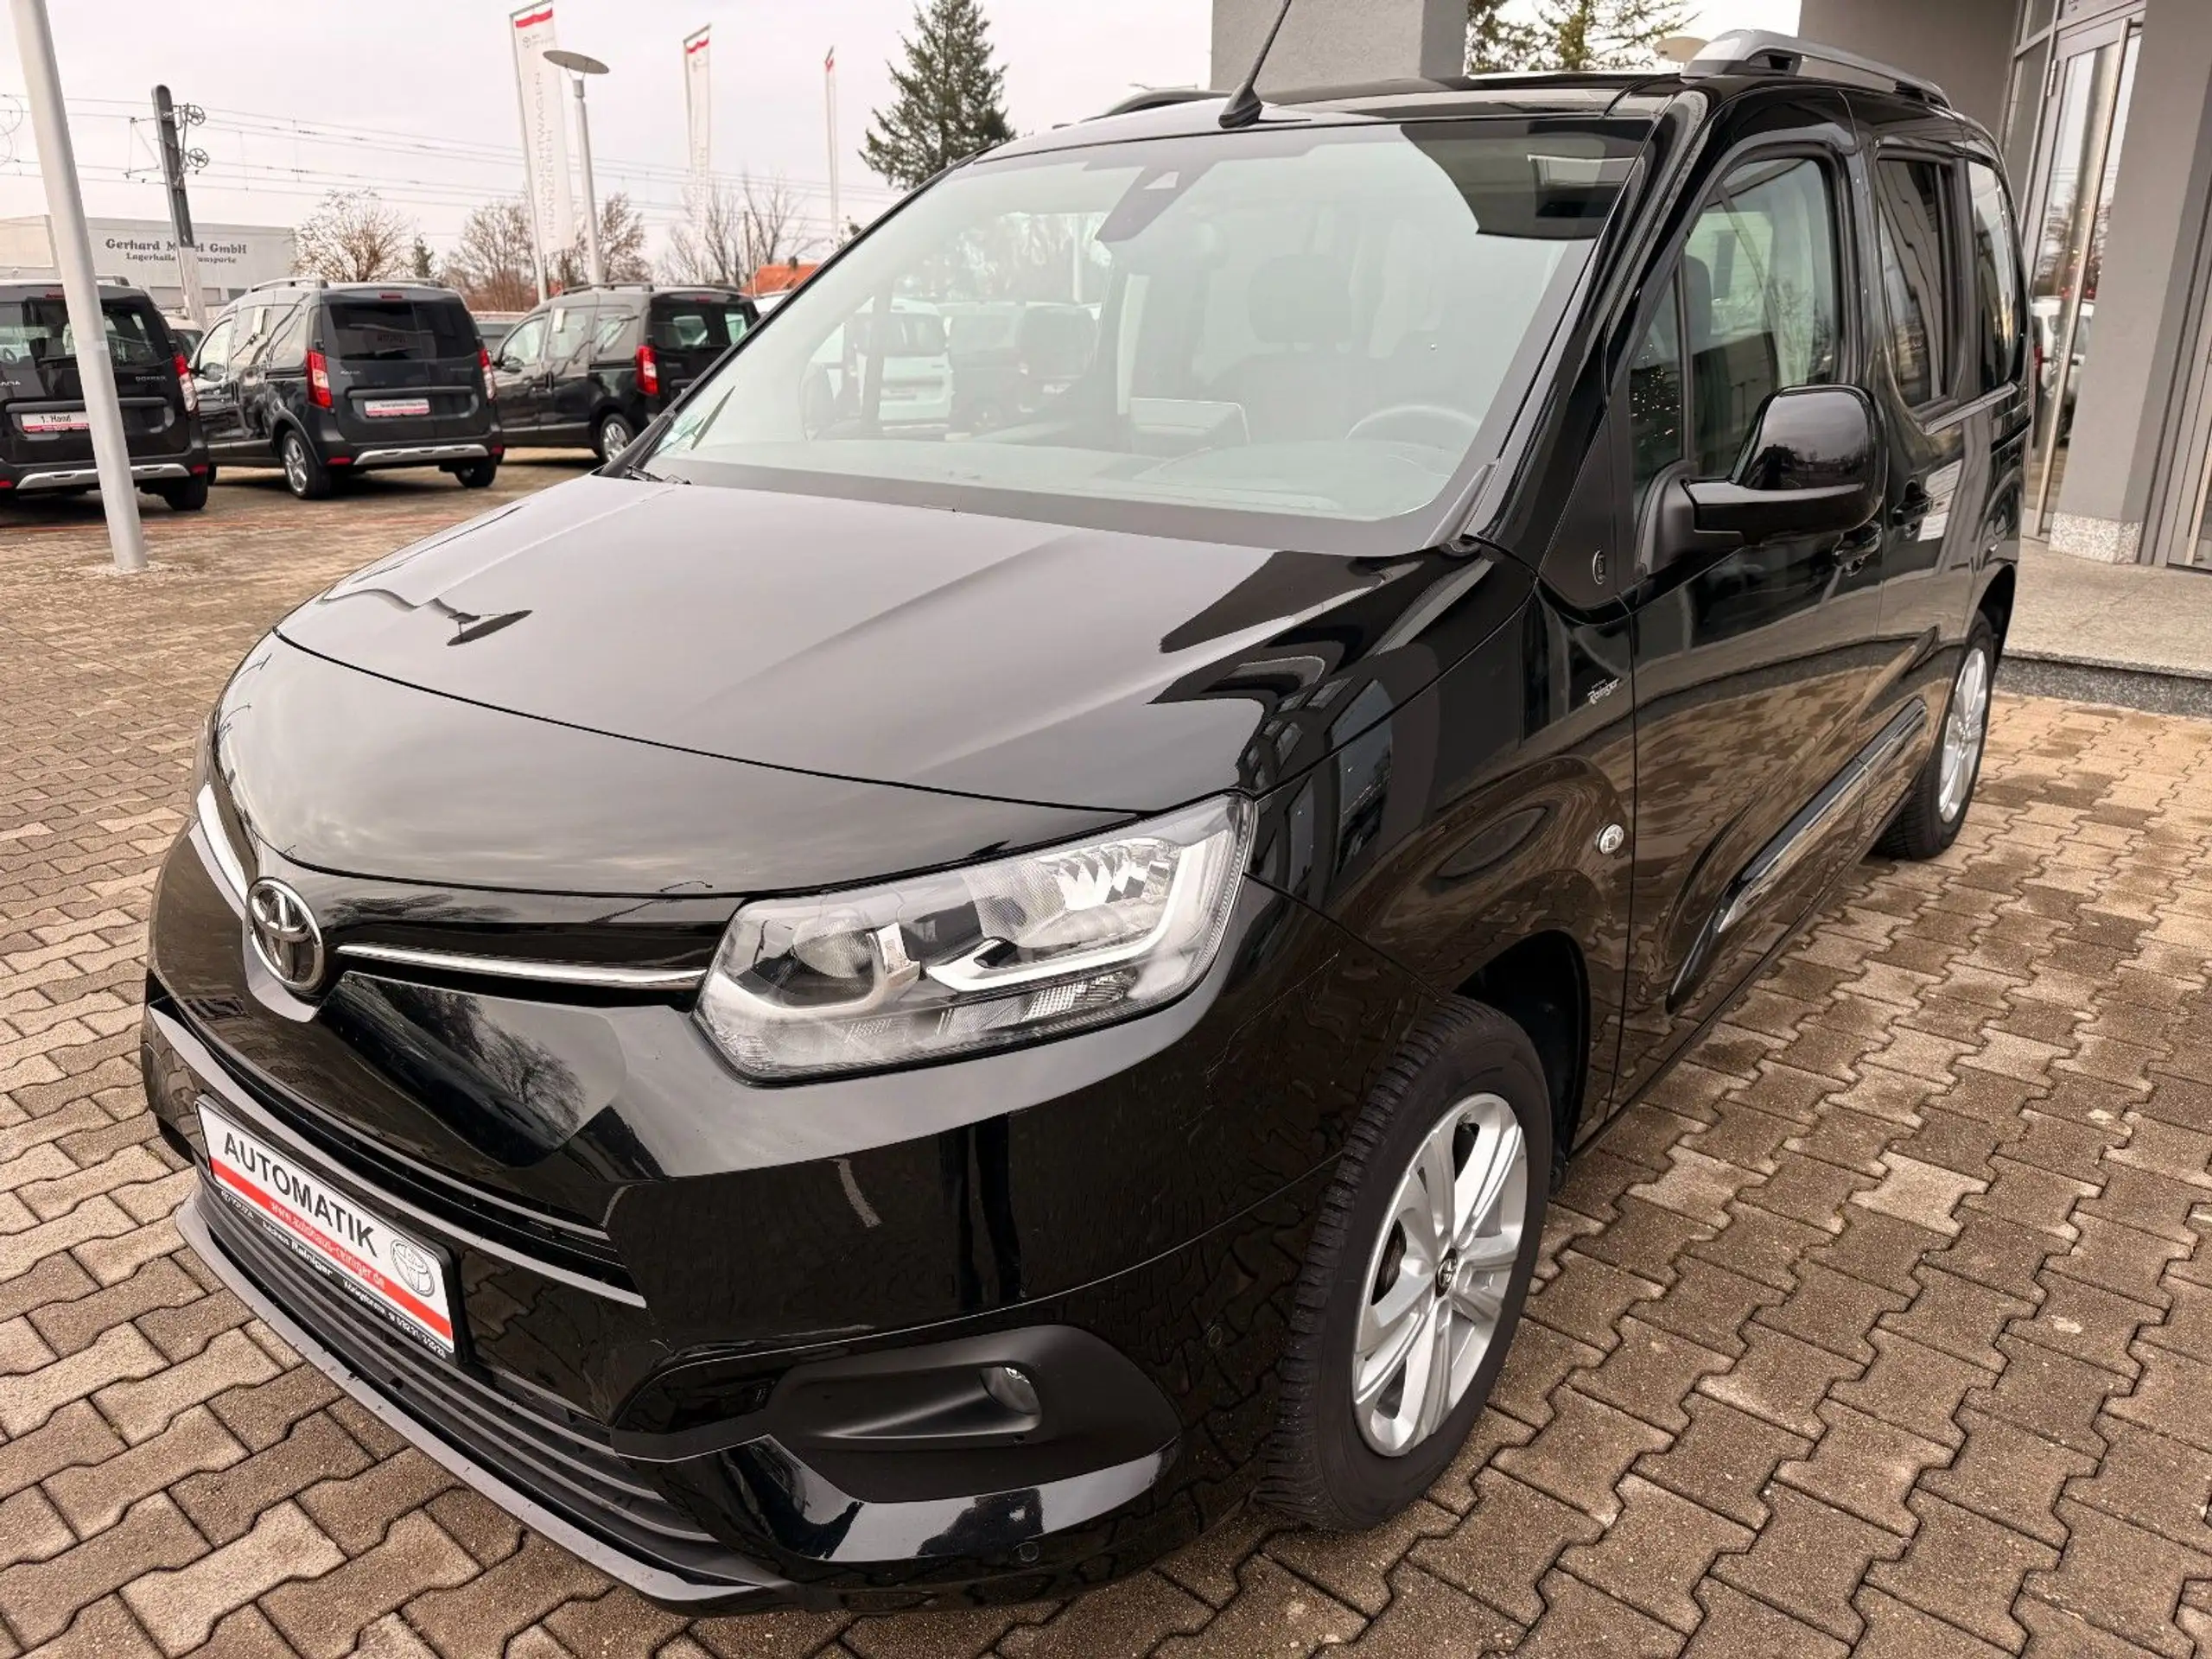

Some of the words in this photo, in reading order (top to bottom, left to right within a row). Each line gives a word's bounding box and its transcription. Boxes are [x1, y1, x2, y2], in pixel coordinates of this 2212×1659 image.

[105, 238, 161, 251] Gerhard
[209, 243, 248, 255] GmbH
[126, 251, 176, 263] Lagerhalle
[50, 414, 72, 423] Hand
[224, 1132, 378, 1258] AUTOMATIK
